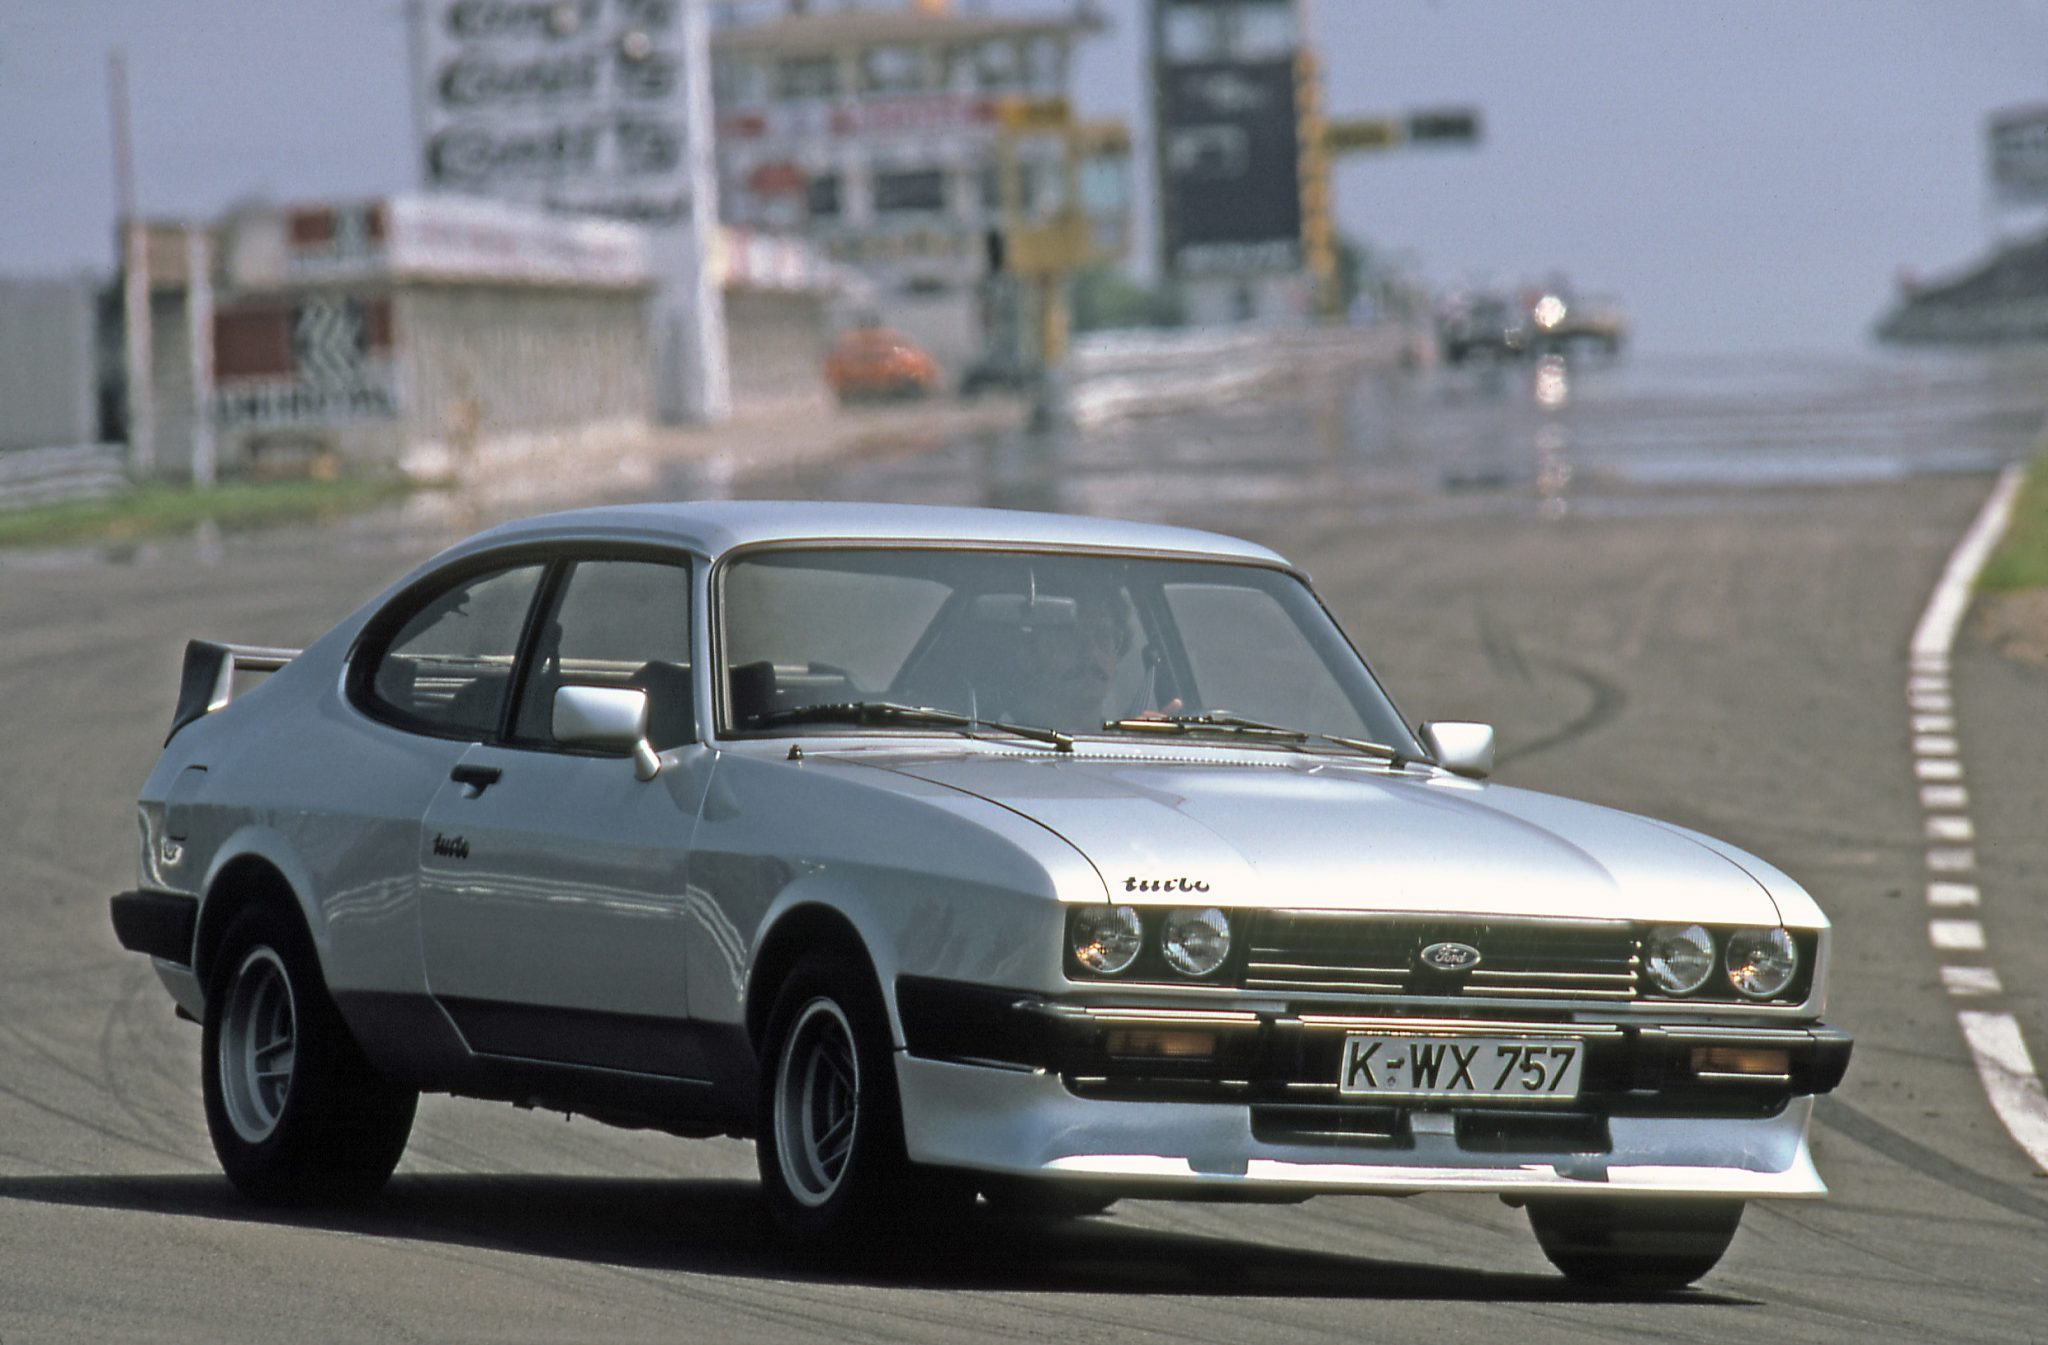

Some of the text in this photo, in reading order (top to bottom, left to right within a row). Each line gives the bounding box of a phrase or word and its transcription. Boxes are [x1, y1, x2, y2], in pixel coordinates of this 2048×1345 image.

[433, 832, 470, 859] turbo
[1121, 876, 1210, 893] turbo
[1435, 946, 1467, 964] Ford
[1493, 1046, 1577, 1092] 757
